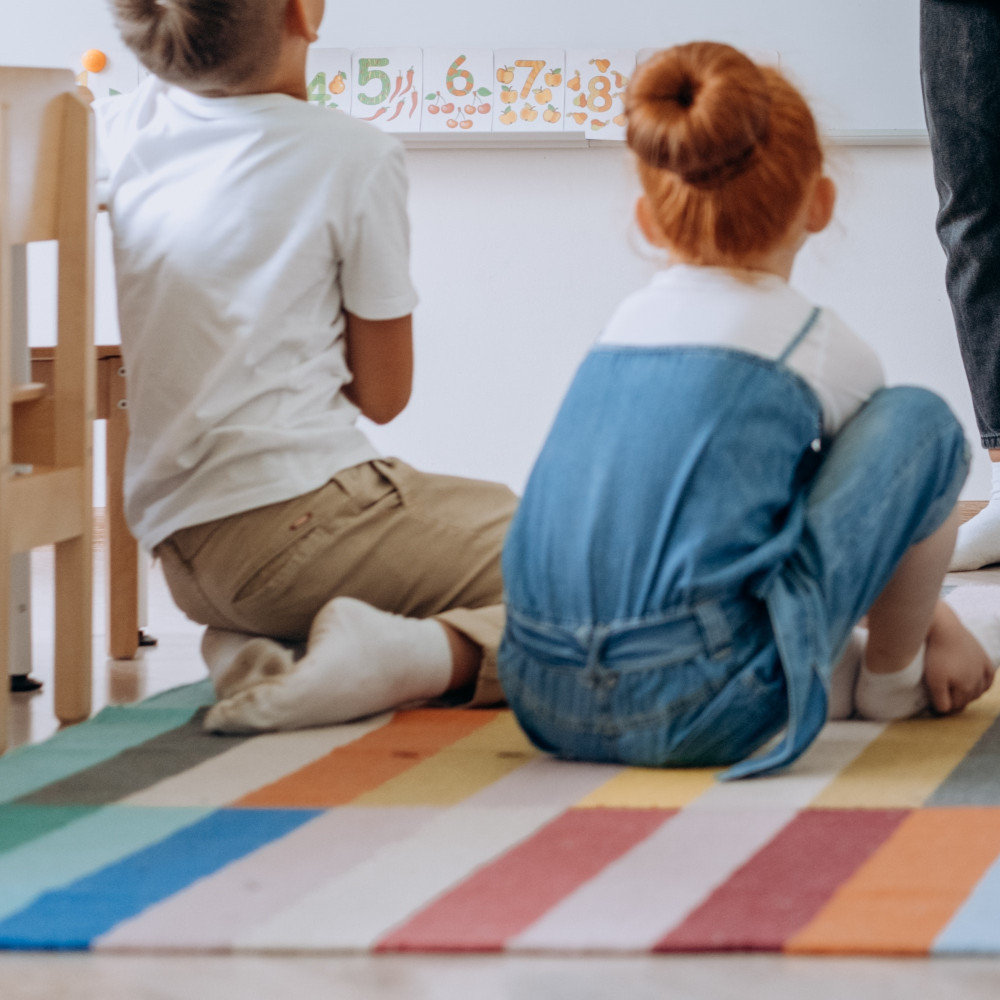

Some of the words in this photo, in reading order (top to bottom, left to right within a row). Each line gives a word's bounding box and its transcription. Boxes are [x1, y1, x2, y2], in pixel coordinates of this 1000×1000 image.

[357, 57, 391, 105] 5
[446, 55, 474, 96] 6
[514, 59, 546, 99] 7
[587, 75, 613, 112] 8
